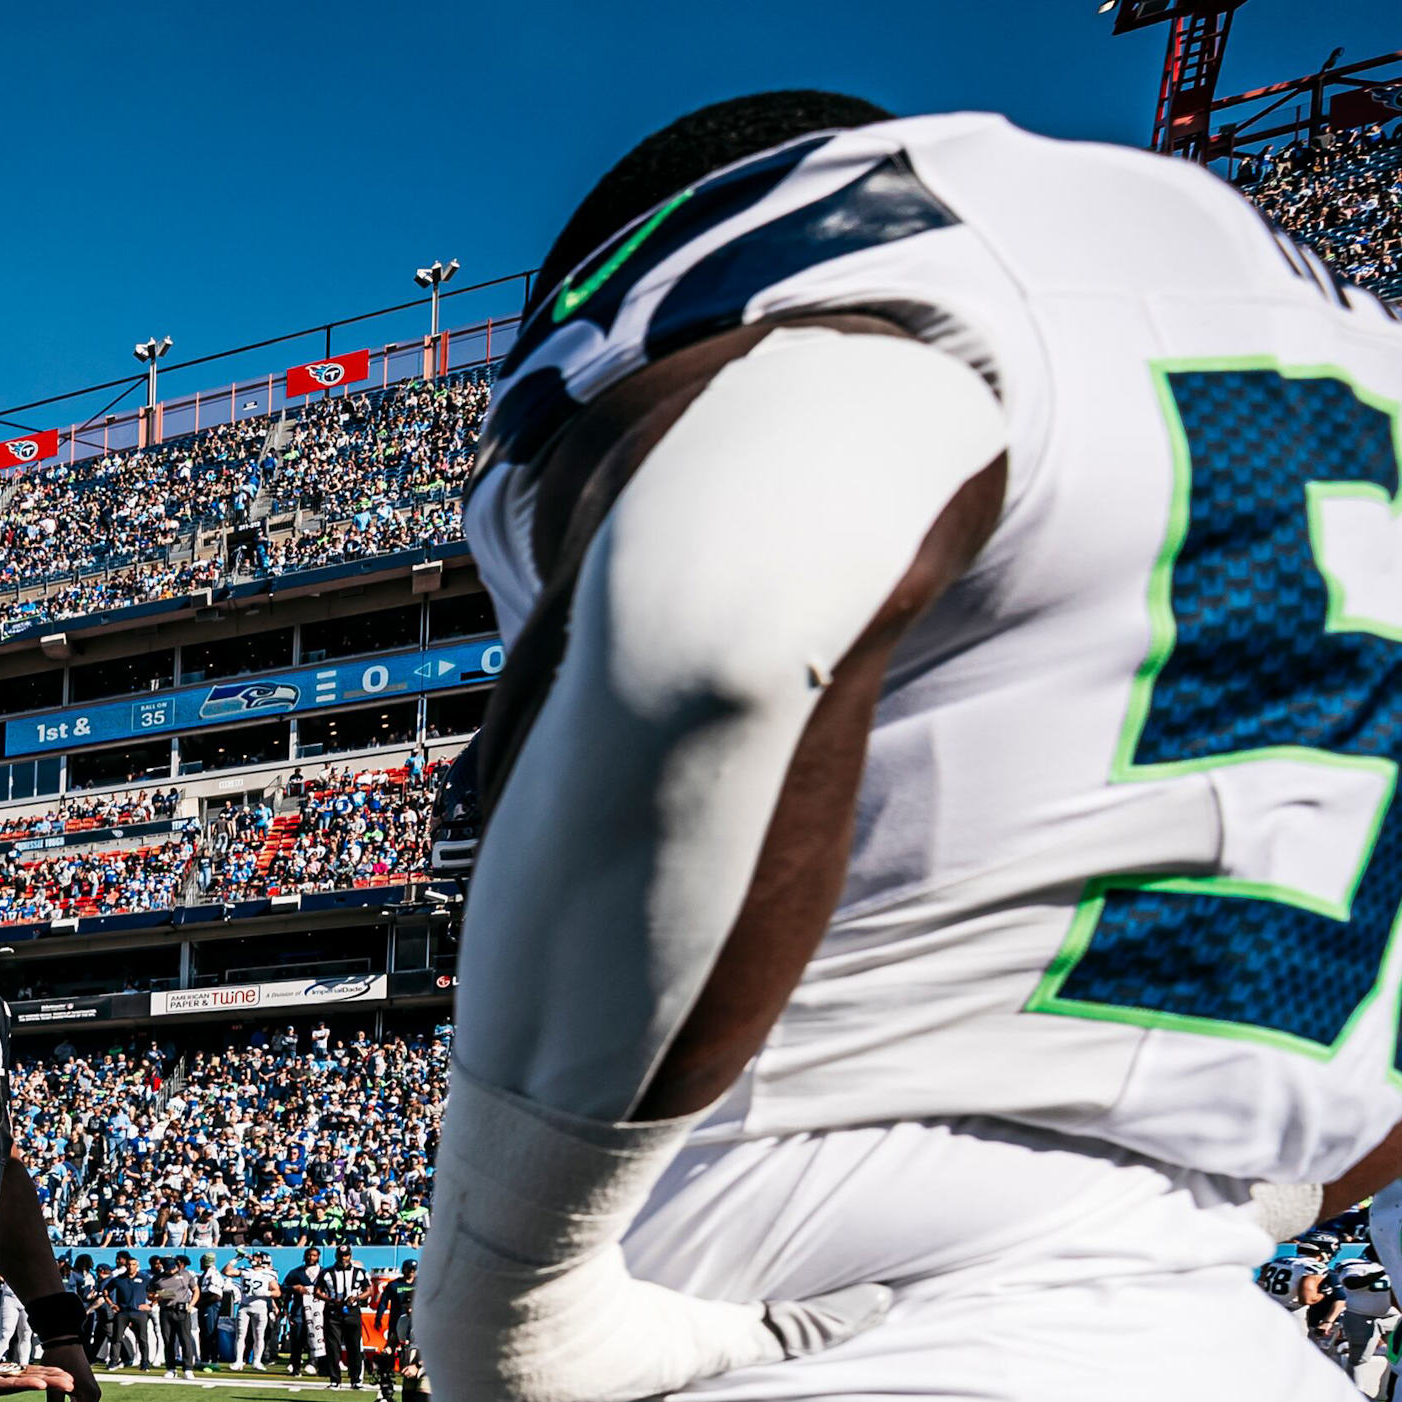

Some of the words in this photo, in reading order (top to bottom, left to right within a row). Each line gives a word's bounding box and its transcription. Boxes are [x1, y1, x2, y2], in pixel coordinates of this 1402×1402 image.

[361, 665, 389, 693] 0
[141, 710, 166, 726] 35
[1024, 355, 1402, 1085] 5
[36, 722, 71, 743] 1st
[72, 717, 91, 737] &
[170, 993, 210, 1001] AMERICAN
[170, 1000, 200, 1009] PAPER
